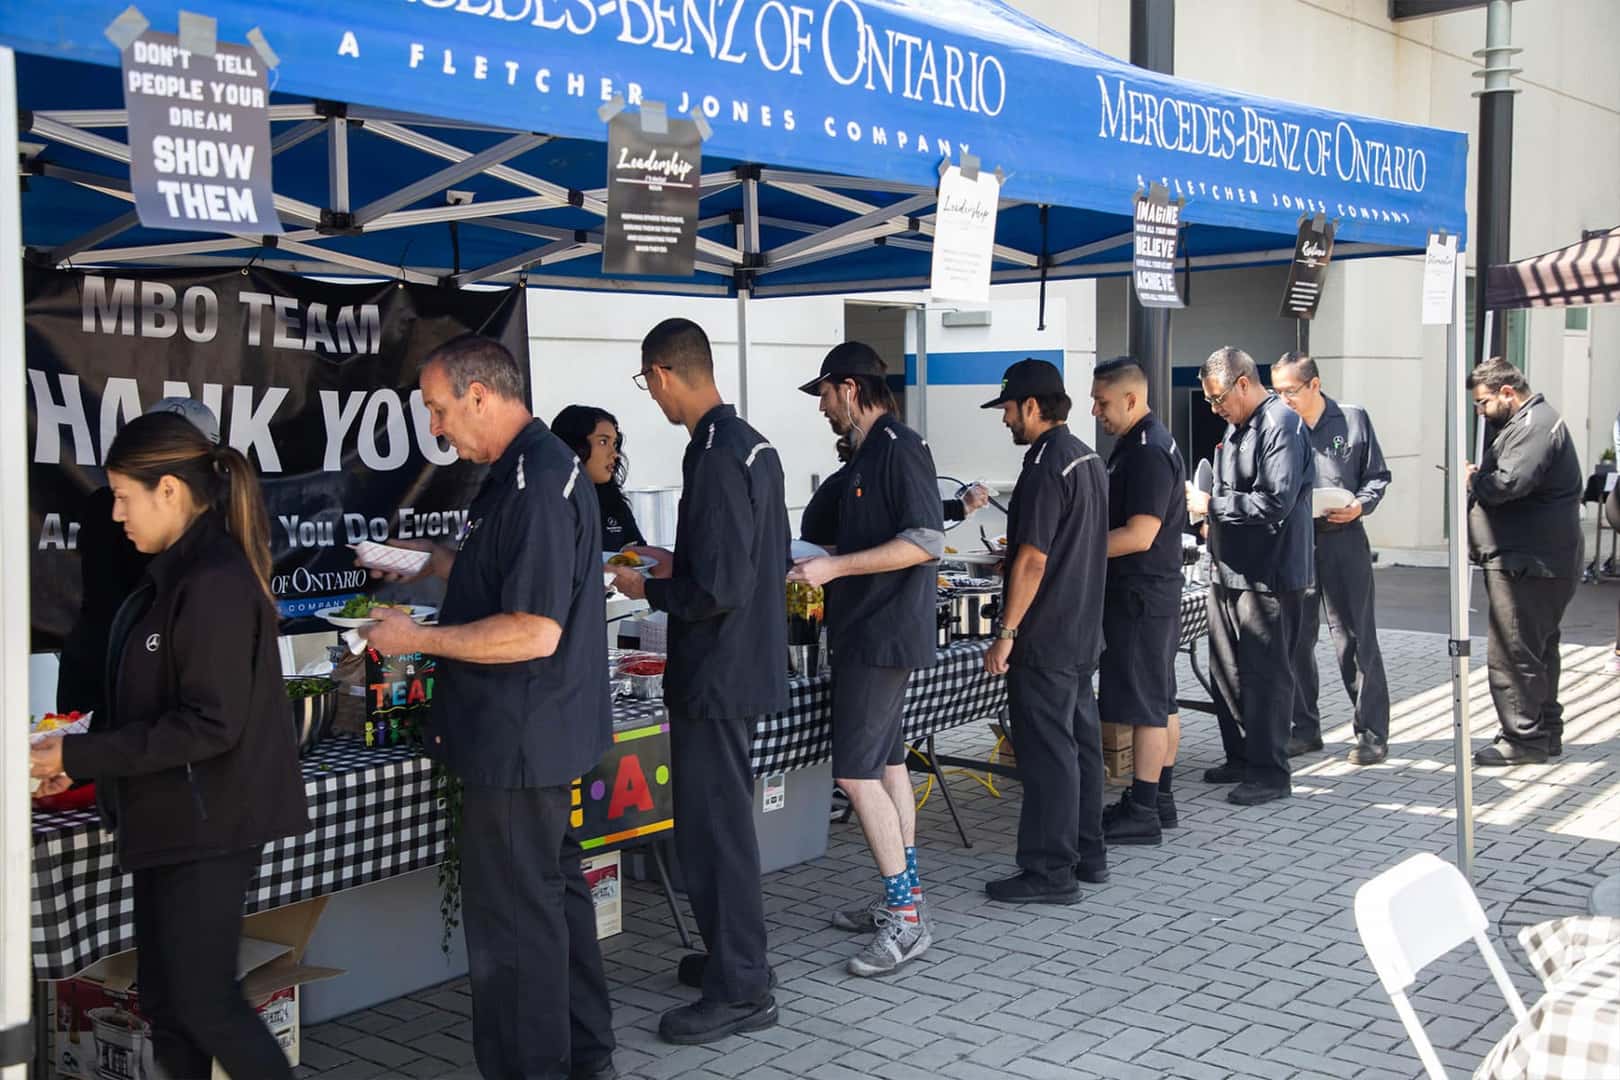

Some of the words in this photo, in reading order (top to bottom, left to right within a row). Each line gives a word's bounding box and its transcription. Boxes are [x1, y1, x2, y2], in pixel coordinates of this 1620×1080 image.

[133, 40, 192, 69] DON'T
[214, 53, 257, 77] TELL
[755, 1, 814, 75] OF
[822, 0, 1006, 117] ONTARIO
[128, 71, 204, 101] PEOPLE
[210, 81, 265, 108] YOUR
[337, 31, 360, 58] A
[409, 43, 643, 105] FLETCHER
[678, 91, 796, 131] JONES
[824, 117, 970, 157] COMPANY
[169, 107, 233, 132] DREAM
[1096, 75, 1301, 172] MERCEDES-BENZ
[1304, 128, 1332, 176] OF
[1335, 121, 1427, 192] ONTARIO
[152, 135, 255, 180] SHOW
[616, 147, 693, 181] Leadership
[157, 180, 258, 224] THEM
[1136, 201, 1179, 225] IMAGINE
[1272, 193, 1326, 214] JONES
[1337, 203, 1410, 224] COMPANY
[1135, 235, 1176, 259] BELIEVE
[81, 275, 219, 343] MBO
[239, 291, 381, 354] TEAM
[278, 515, 335, 548] You
[343, 512, 390, 544] Do
[271, 575, 291, 595] OF
[292, 566, 367, 593] ONTARIO
[607, 753, 656, 820] A
